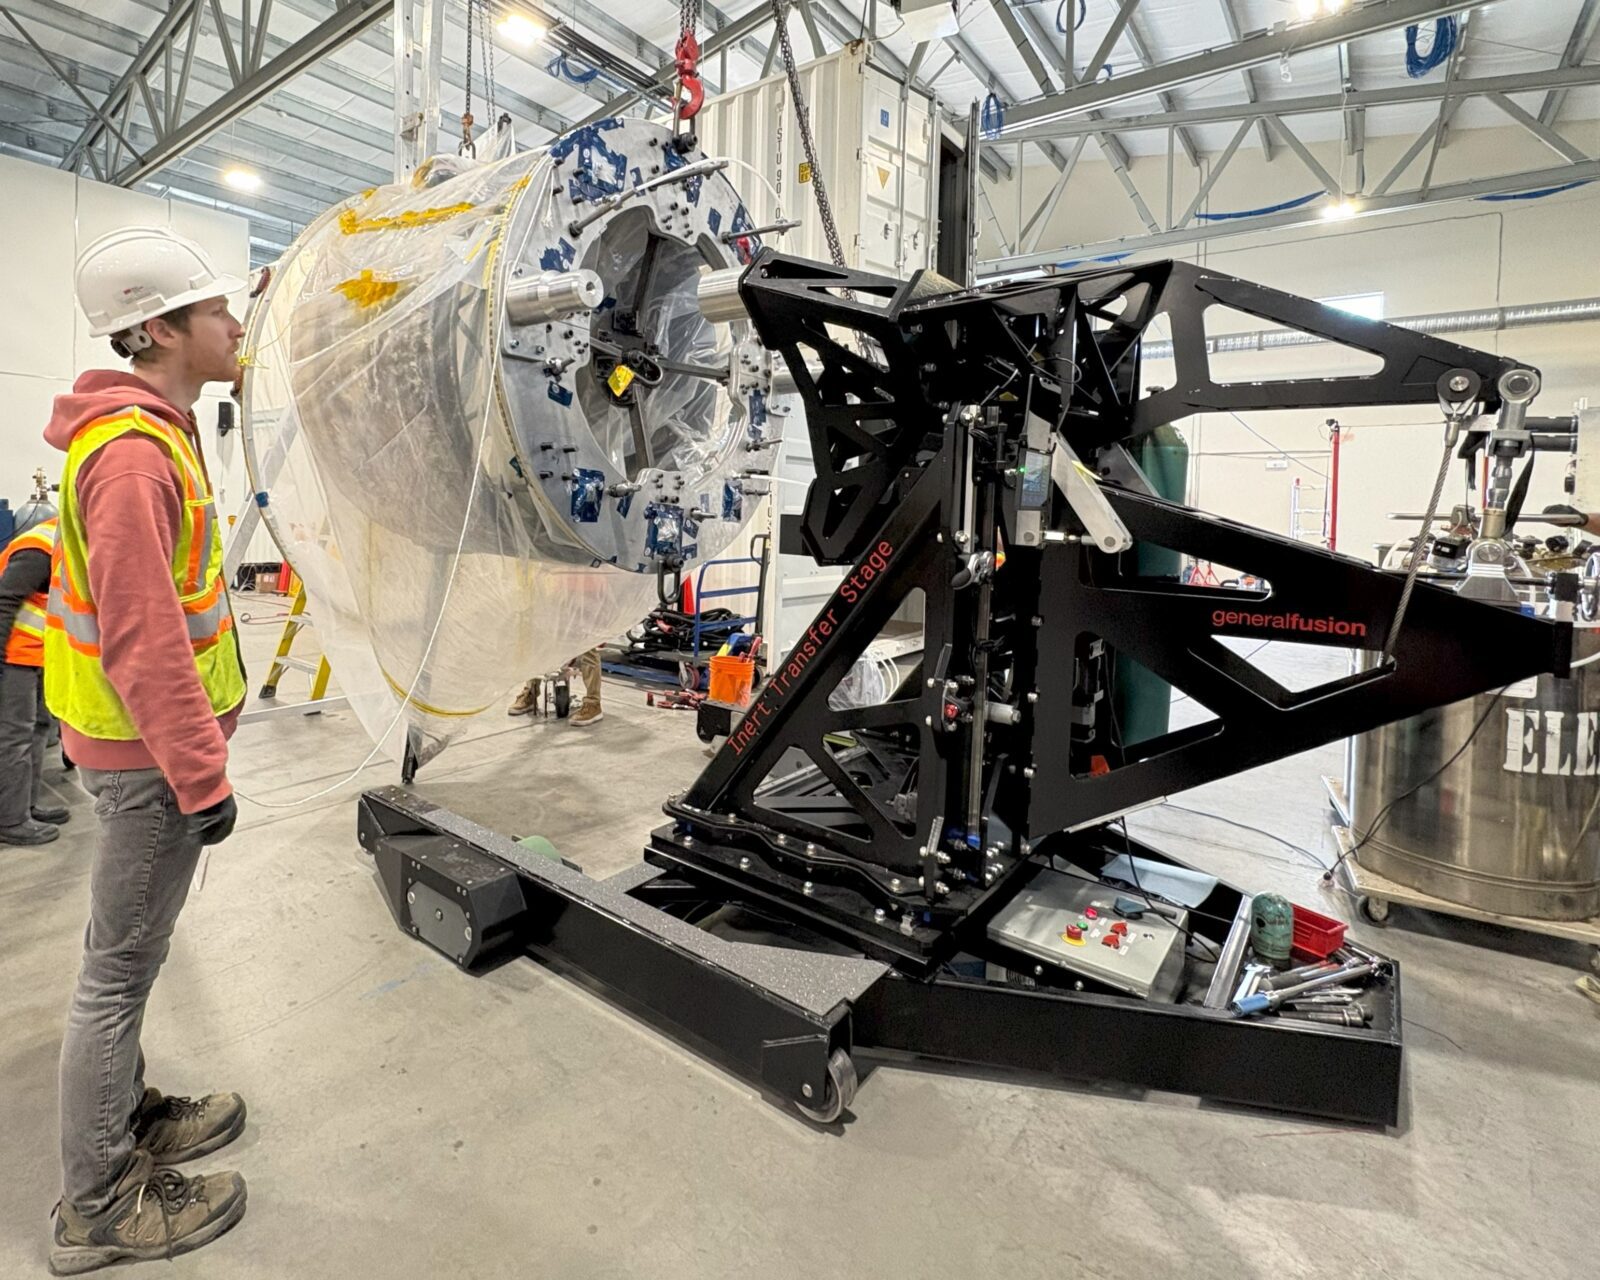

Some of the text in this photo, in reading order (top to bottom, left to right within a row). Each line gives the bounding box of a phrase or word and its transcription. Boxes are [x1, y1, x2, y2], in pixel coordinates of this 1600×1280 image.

[727, 540, 894, 756] Inert Transfer Stage
[1212, 610, 1366, 636] generalfusion
[1503, 707, 1600, 776] ELE
